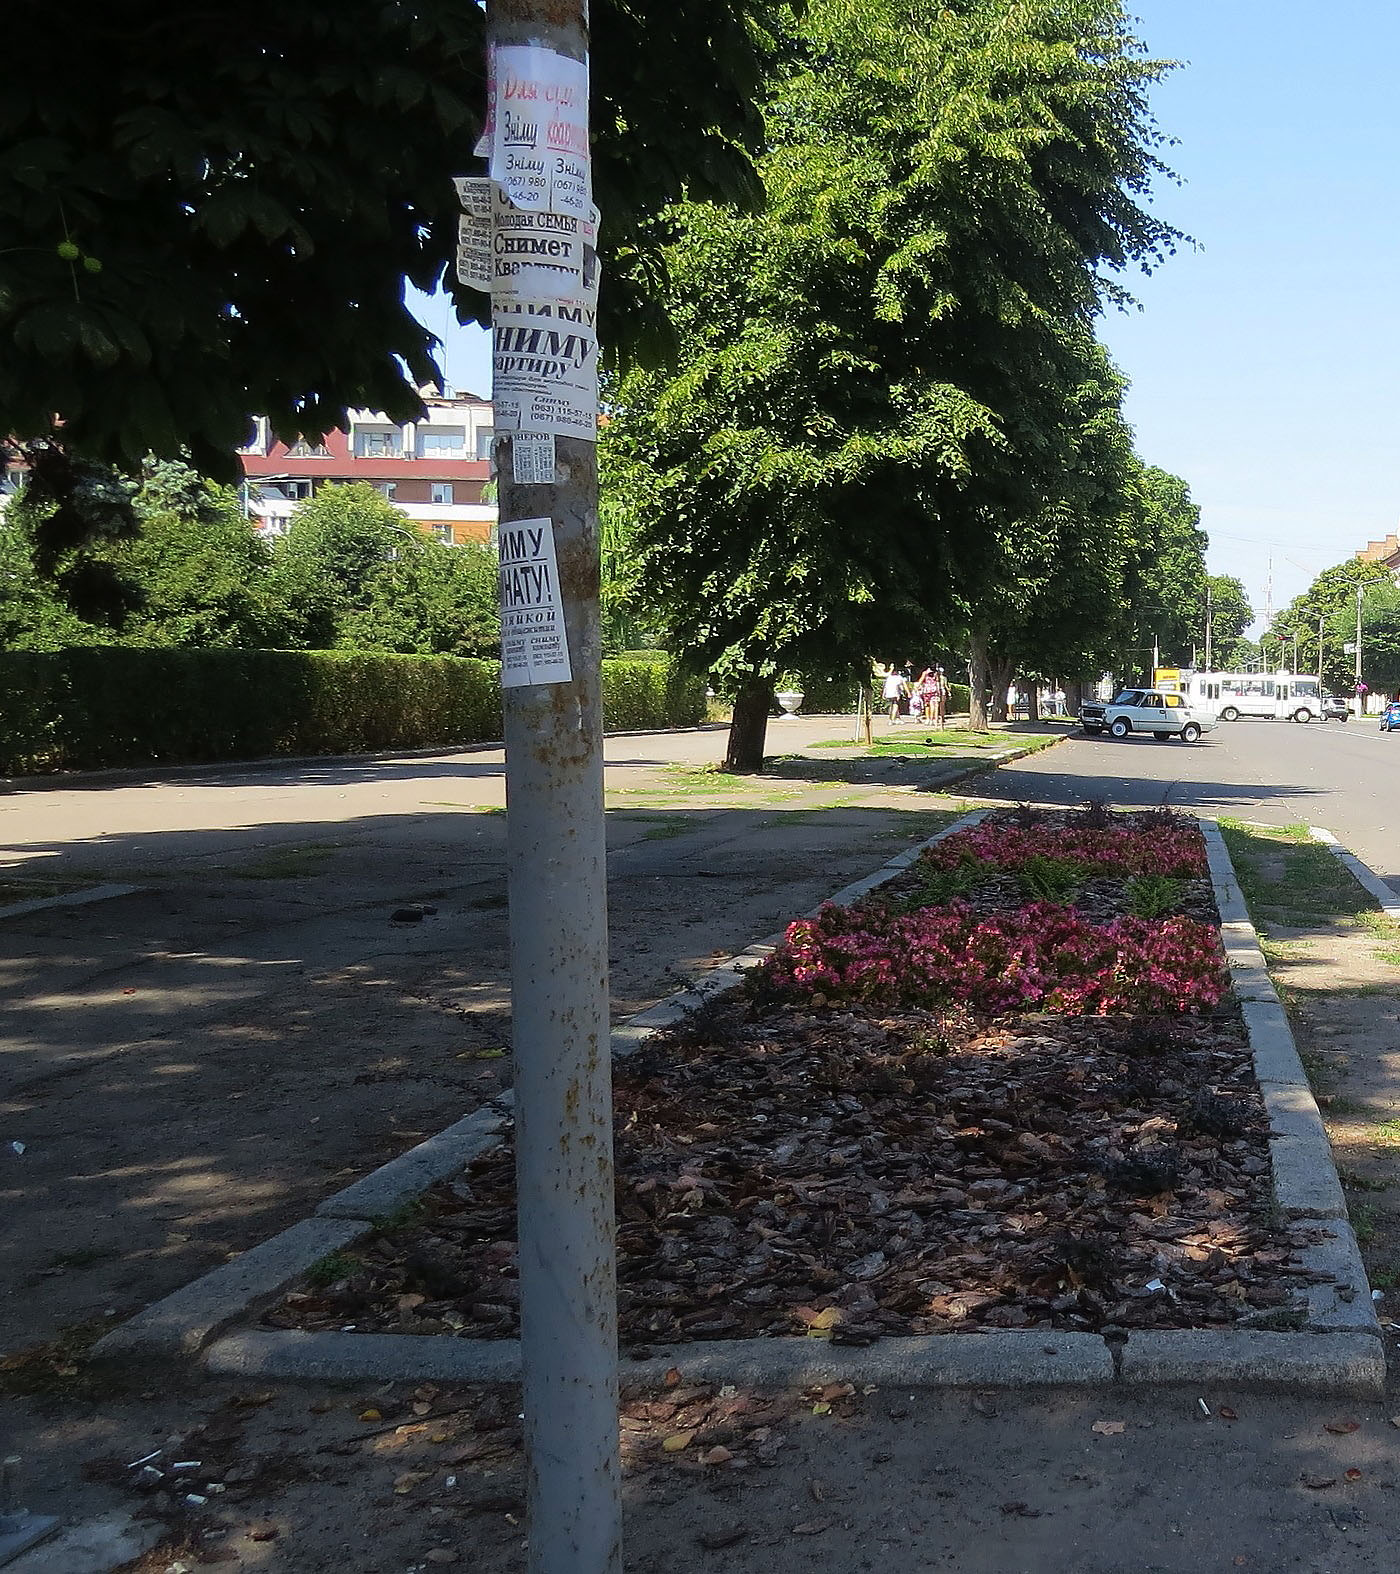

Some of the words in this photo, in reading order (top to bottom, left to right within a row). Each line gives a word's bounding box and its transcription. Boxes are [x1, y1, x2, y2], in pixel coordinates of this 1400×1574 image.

[504, 110, 538, 147] Зніму
[506, 153, 545, 175] Зніму
[537, 212, 578, 233] СЕМЬЯ
[494, 232, 573, 258] Снимет
[493, 319, 596, 369] НИМУ
[494, 355, 572, 379] артиру
